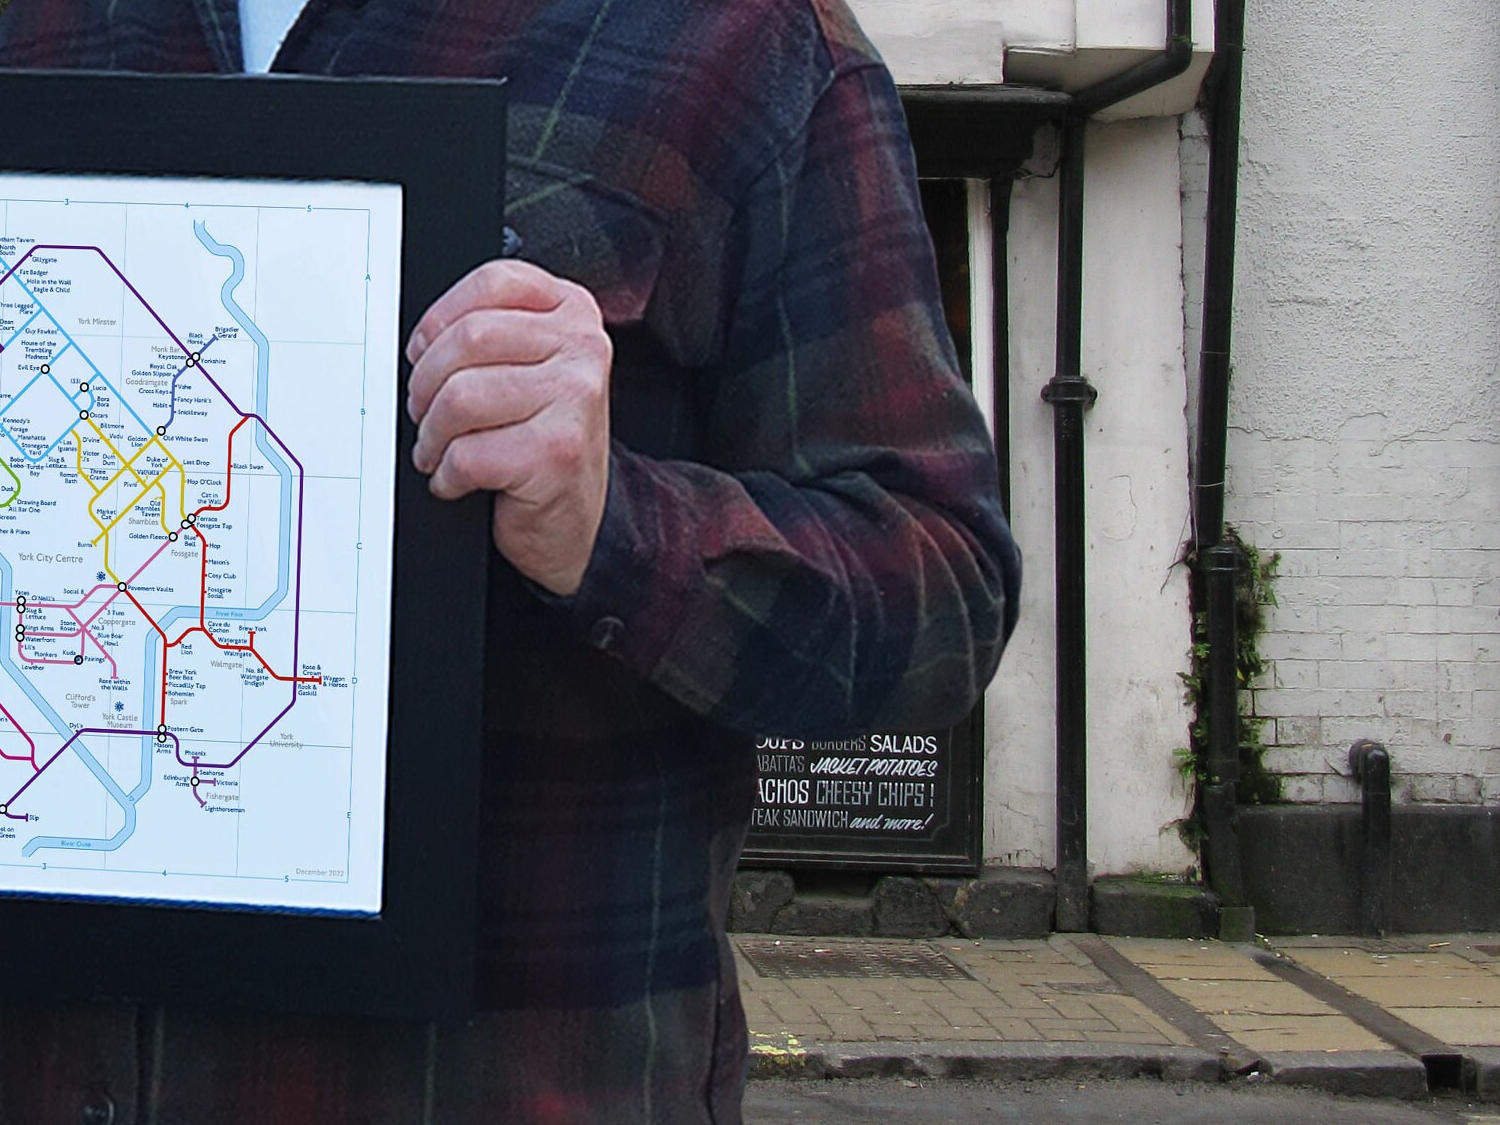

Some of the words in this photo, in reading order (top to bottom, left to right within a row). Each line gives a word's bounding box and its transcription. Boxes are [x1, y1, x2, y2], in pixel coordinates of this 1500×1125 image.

[18, 552, 34, 561] York
[36, 553, 54, 563] City
[55, 554, 83, 563] Centre
[870, 735, 938, 755] SALADS
[810, 757, 869, 774] JACKET
[864, 759, 938, 777] POTATOES
[816, 780, 872, 805] CHEESY
[878, 782, 925, 807] CHIPS
[783, 809, 849, 829] SANDWICH
[850, 814, 884, 829] and
[882, 813, 934, 831] more!
[295, 867, 327, 876] December
